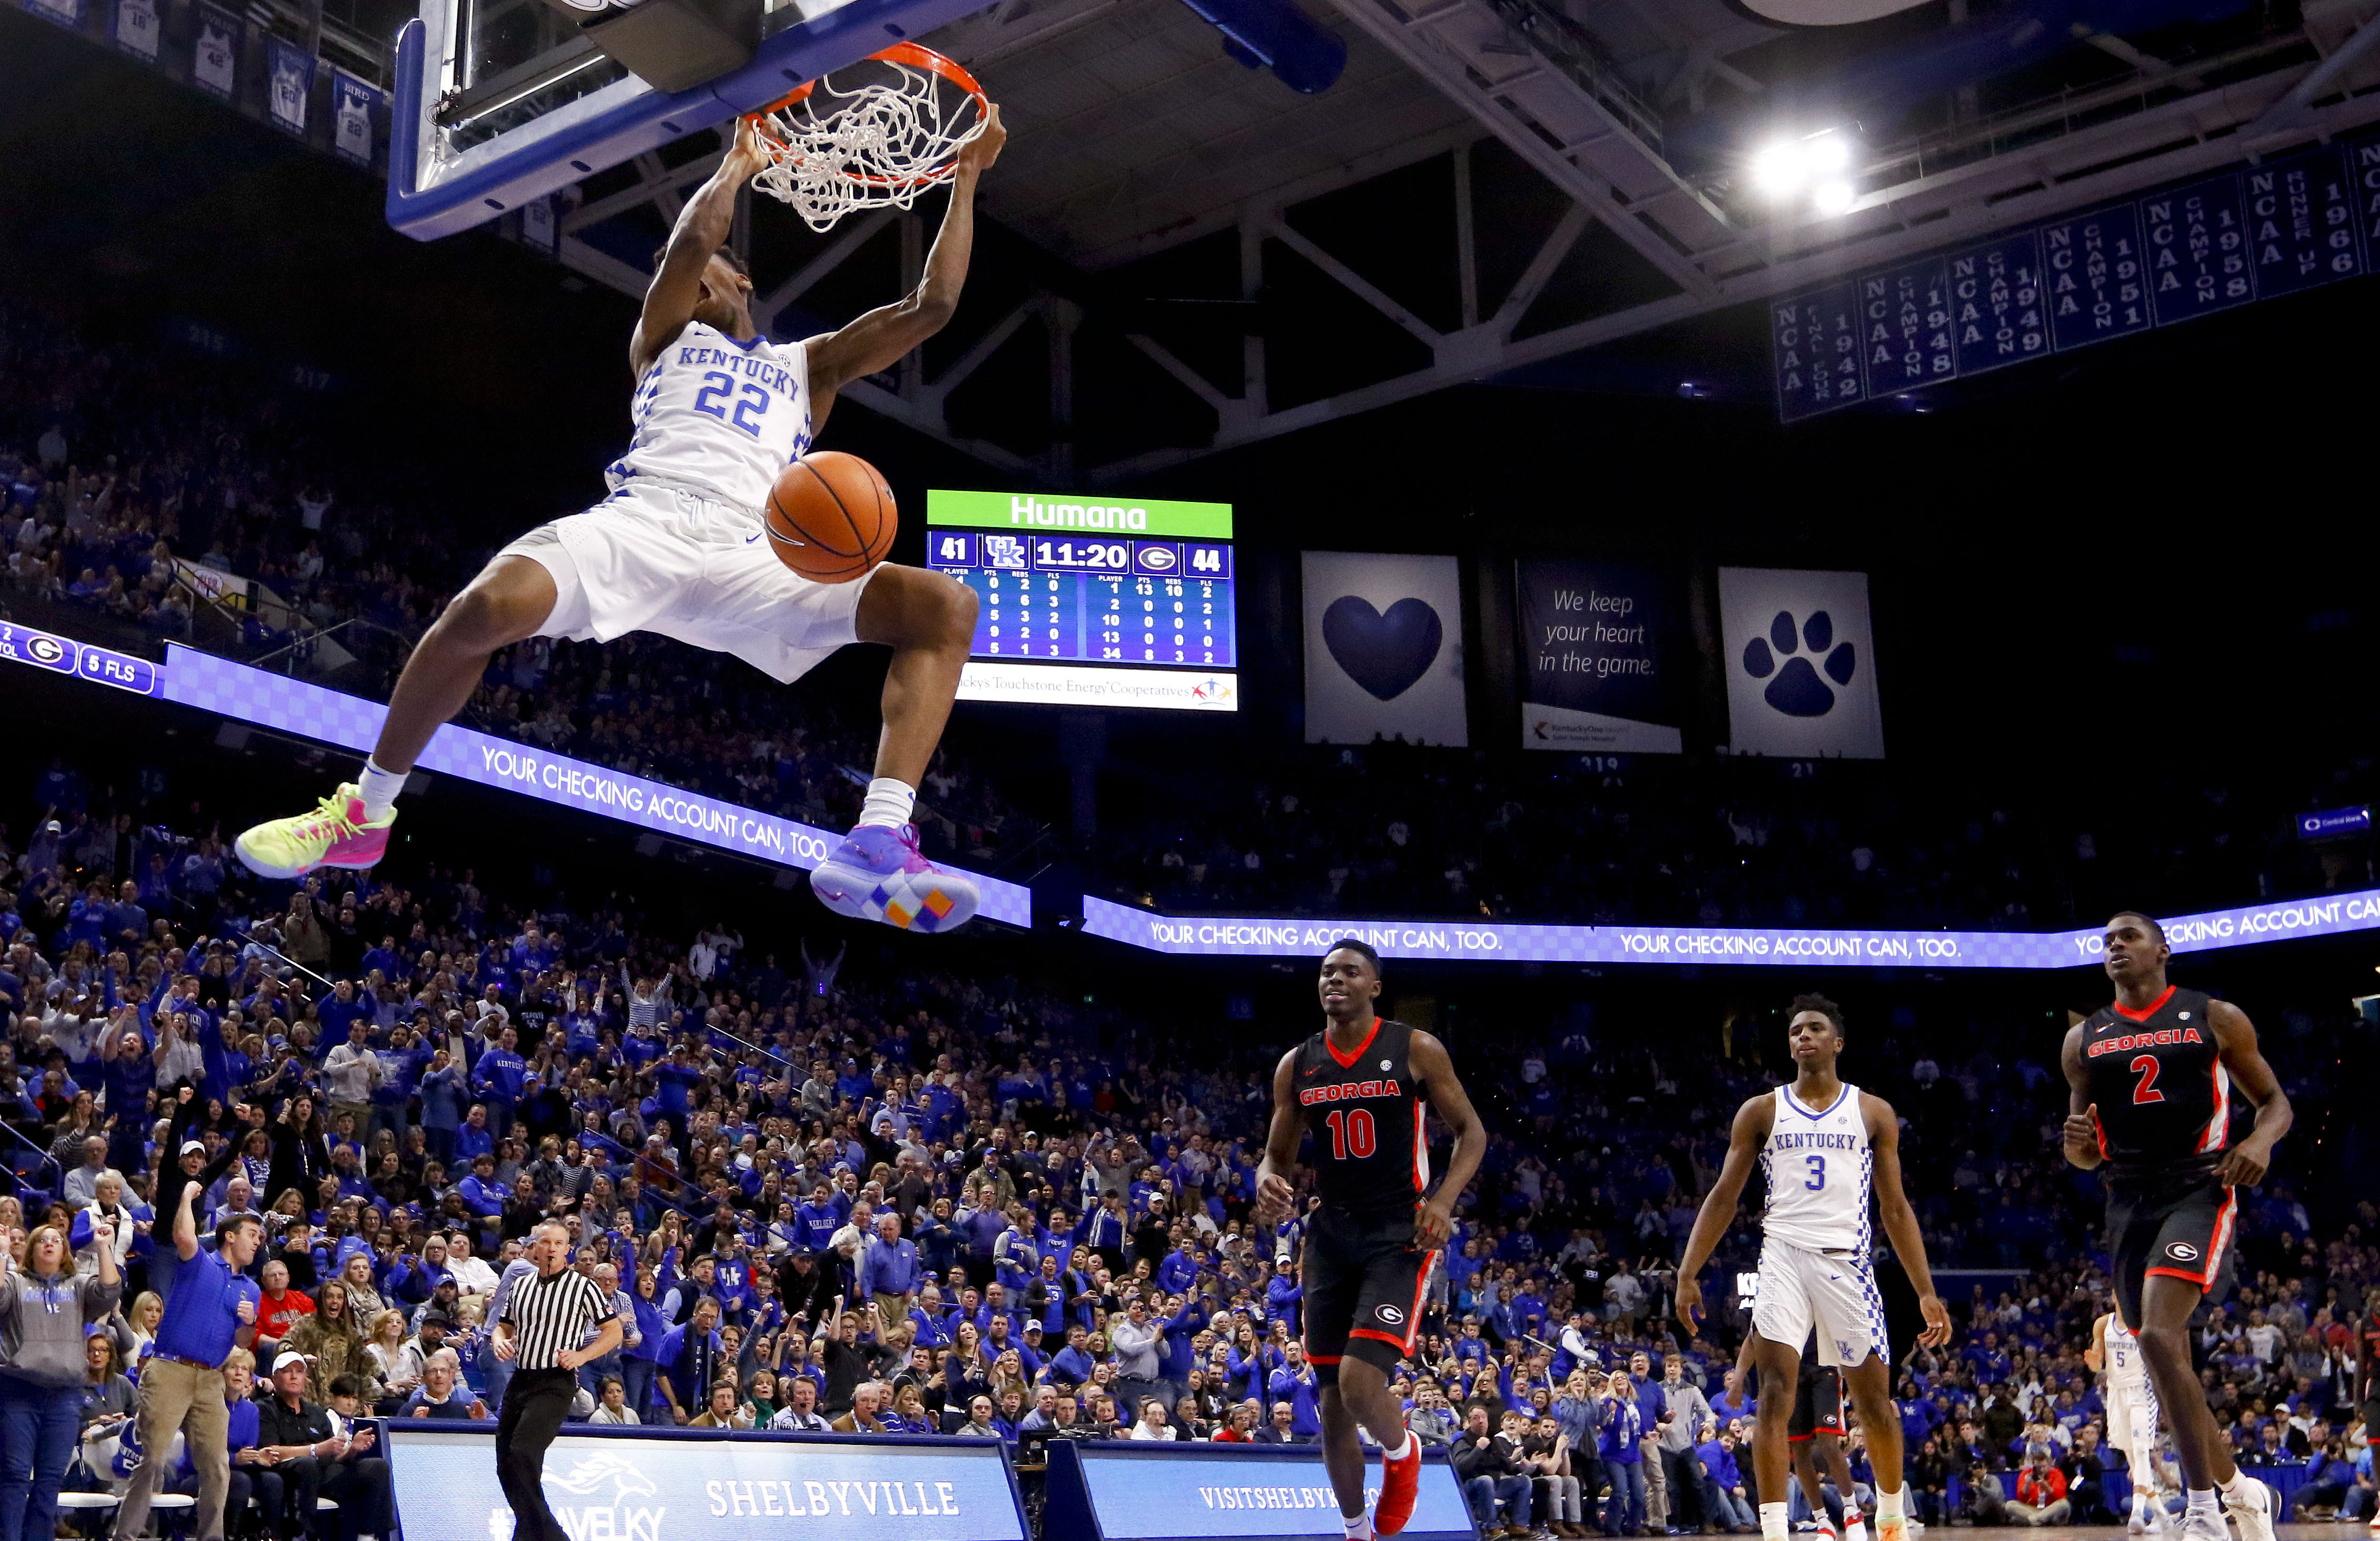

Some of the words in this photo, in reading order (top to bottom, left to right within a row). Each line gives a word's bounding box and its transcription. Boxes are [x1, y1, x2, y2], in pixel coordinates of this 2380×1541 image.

[344, 81, 370, 101] BIRD
[2251, 171, 2284, 265] NCAA
[2325, 182, 2353, 273] 1966
[2148, 200, 2182, 293] NCAA
[2185, 196, 2216, 303] CHAMPION
[2218, 209, 2248, 298] 1958
[2049, 226, 2080, 316] NCAA
[2083, 224, 2112, 329] CHAMPION
[2115, 237, 2141, 326] 1951
[1954, 257, 1983, 345] NCAA
[1988, 252, 2014, 355] CHAMPION
[2016, 266, 2042, 351] 1949
[1868, 278, 1891, 365] NCAA
[1898, 276, 1921, 378] CHAMPION
[1928, 290, 1952, 374] 1948
[1778, 306, 1803, 391] NCAA
[1836, 314, 1857, 397] 1942
[678, 347, 799, 401] KENTUCKY
[694, 371, 770, 437] 22
[1011, 496, 1147, 530] Humana
[940, 537, 966, 560] 41
[986, 536, 1024, 567] UK
[1037, 542, 1127, 568] 11:20
[1193, 549, 1221, 572] 44
[989, 577, 999, 589] 0
[1020, 578, 1030, 590] 2
[1049, 580, 1059, 591] 0
[1110, 583, 1119, 594] 1
[1135, 584, 1153, 595] 13
[1165, 585, 1183, 597] 10
[1202, 586, 1212, 598] 2
[990, 593, 999, 605] 6
[1020, 594, 1030, 606] 6
[1049, 595, 1059, 607] 3
[1110, 598, 1120, 610] 2
[1144, 600, 1154, 612] 0
[1174, 601, 1183, 613] 0
[1203, 603, 1212, 615] 2
[1555, 590, 1584, 611] We
[1589, 591, 1633, 618] keep
[990, 609, 999, 620] 5
[1020, 610, 1030, 622] 3
[1049, 612, 1059, 623] 2
[1102, 614, 1120, 626] 10
[1144, 616, 1154, 628] 0
[1174, 617, 1184, 629] 0
[1203, 618, 1212, 630] 1
[3, 627, 12, 641] 2
[990, 625, 999, 637] 9
[1020, 626, 1030, 638] 2
[1049, 628, 1059, 640] 0
[1102, 631, 1120, 643] 13
[1144, 633, 1154, 645] 0
[1174, 634, 1184, 646] 0
[1203, 635, 1213, 647] 0
[1545, 626, 1589, 645] your
[1595, 621, 1645, 644] heart
[990, 642, 999, 653] 5
[1021, 643, 1029, 655] 1
[1050, 645, 1059, 656] 3
[1103, 647, 1121, 659] 34
[1145, 649, 1154, 660] 8
[1175, 650, 1184, 662] 3
[1204, 651, 1213, 663] 2
[1539, 650, 1555, 671] in
[1562, 651, 1591, 673] the
[1597, 657, 1654, 678] game.
[88, 655, 100, 672] 5
[106, 660, 136, 682] FLS
[992, 677, 1061, 691] Touchstone
[1067, 680, 1106, 695] Energy
[1111, 682, 1189, 697] Cooperatives
[482, 746, 536, 783] YOUR
[543, 764, 643, 811] CHECKING
[647, 794, 738, 838] ACCOUNT
[742, 820, 785, 855] CAN,
[2240, 902, 2341, 935] ACCOUNT
[2347, 897, 2380, 920] CA
[1151, 922, 1194, 944] YOUR
[1199, 926, 1299, 946] CHECKING
[1403, 930, 1450, 952] CAN,
[1455, 931, 1502, 950] TOO.
[1621, 935, 1670, 954] YOUR
[1675, 935, 1768, 955] CHECKING
[1774, 937, 1862, 956] ACCOUNT
[1867, 938, 1912, 960] CAN,
[1917, 938, 1961, 958] TOO.
[2087, 1028, 2202, 1058] GEORGIA
[496, 1059, 523, 1070] KENTUCKY
[2130, 1054, 2165, 1105] 2
[1300, 1079, 1401, 1106] GEORGIA
[1326, 1109, 1375, 1160] 10
[1775, 1133, 1857, 1150] KENTUCKY
[1806, 1155, 1825, 1190] 3
[809, 1218, 836, 1226] KENTUCKY
[2170, 1244, 2197, 1258] G
[1380, 1307, 1403, 1321] G
[1836, 1340, 1855, 1362] UK
[2116, 1352, 2125, 1367] 5
[706, 1480, 959, 1517] SHELBYVILLE
